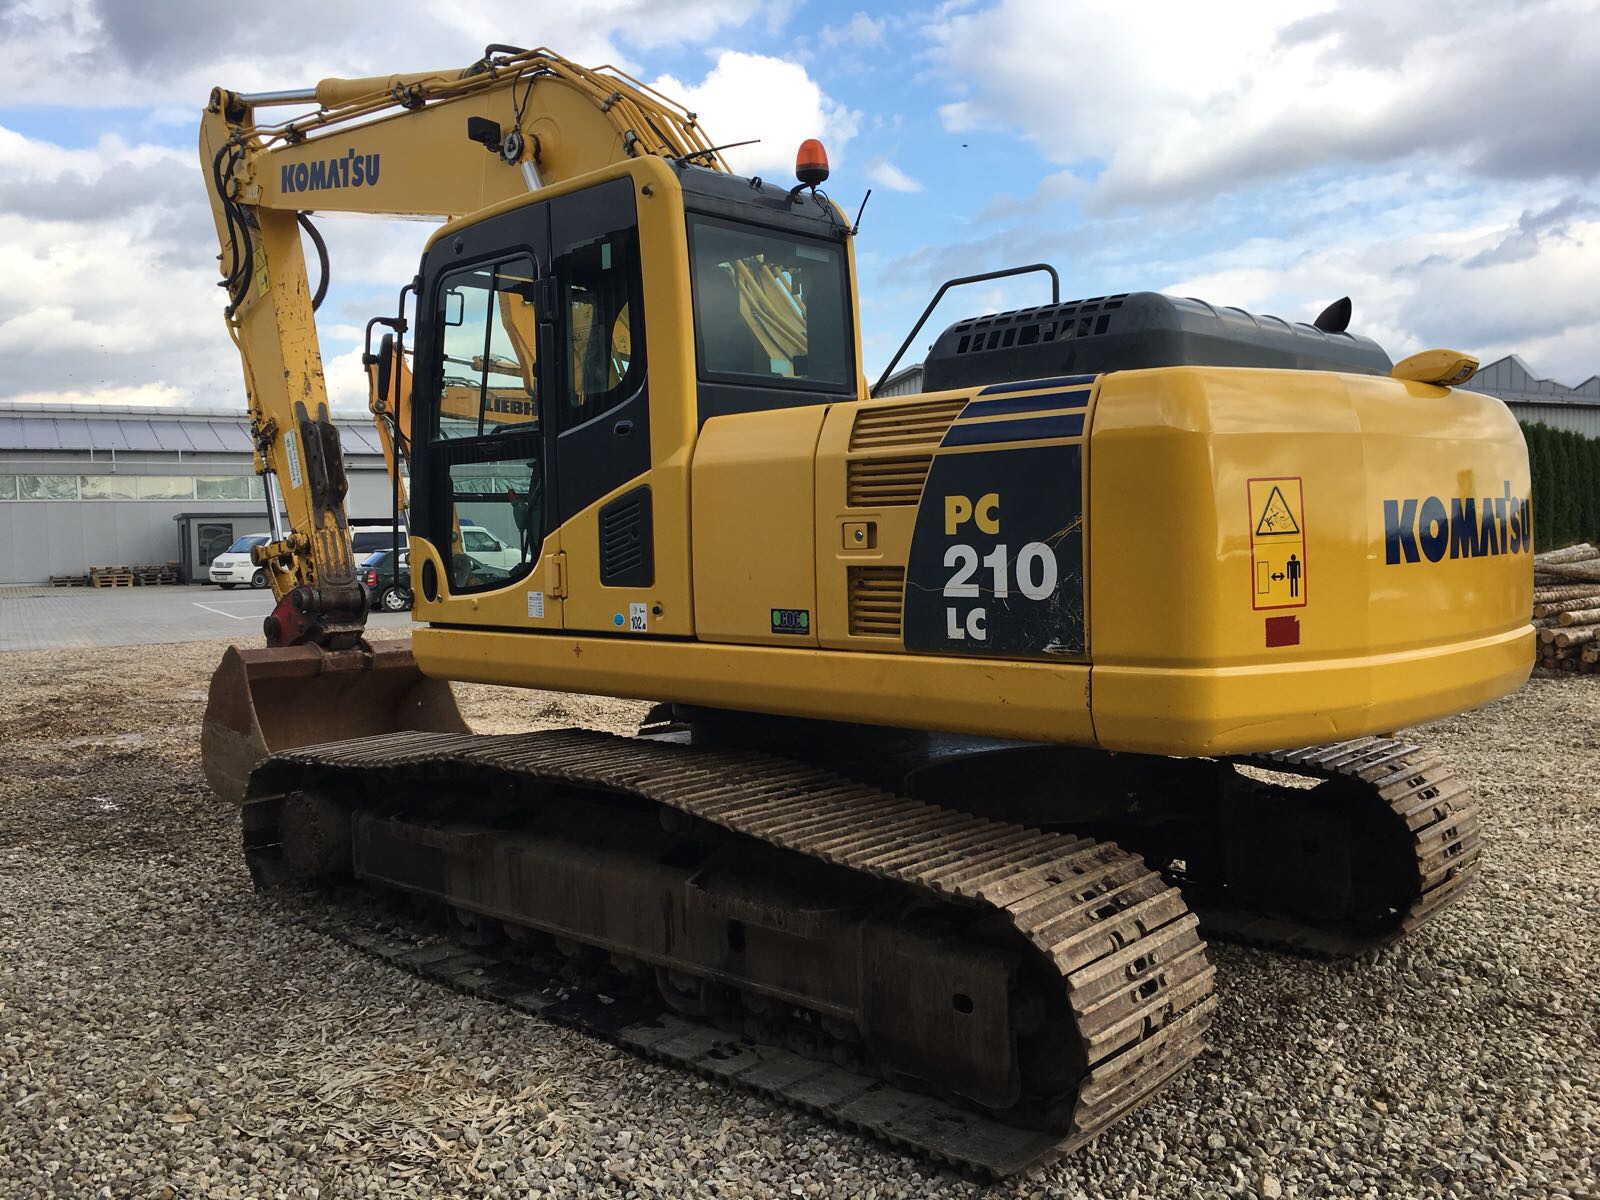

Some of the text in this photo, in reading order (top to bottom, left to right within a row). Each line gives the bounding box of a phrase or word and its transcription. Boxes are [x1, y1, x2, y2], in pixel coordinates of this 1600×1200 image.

[281, 148, 380, 193] KOMATSU
[944, 492, 1000, 535] PC
[1384, 480, 1531, 565] KOMATSU
[943, 541, 1058, 601] 210
[946, 607, 987, 641] LC
